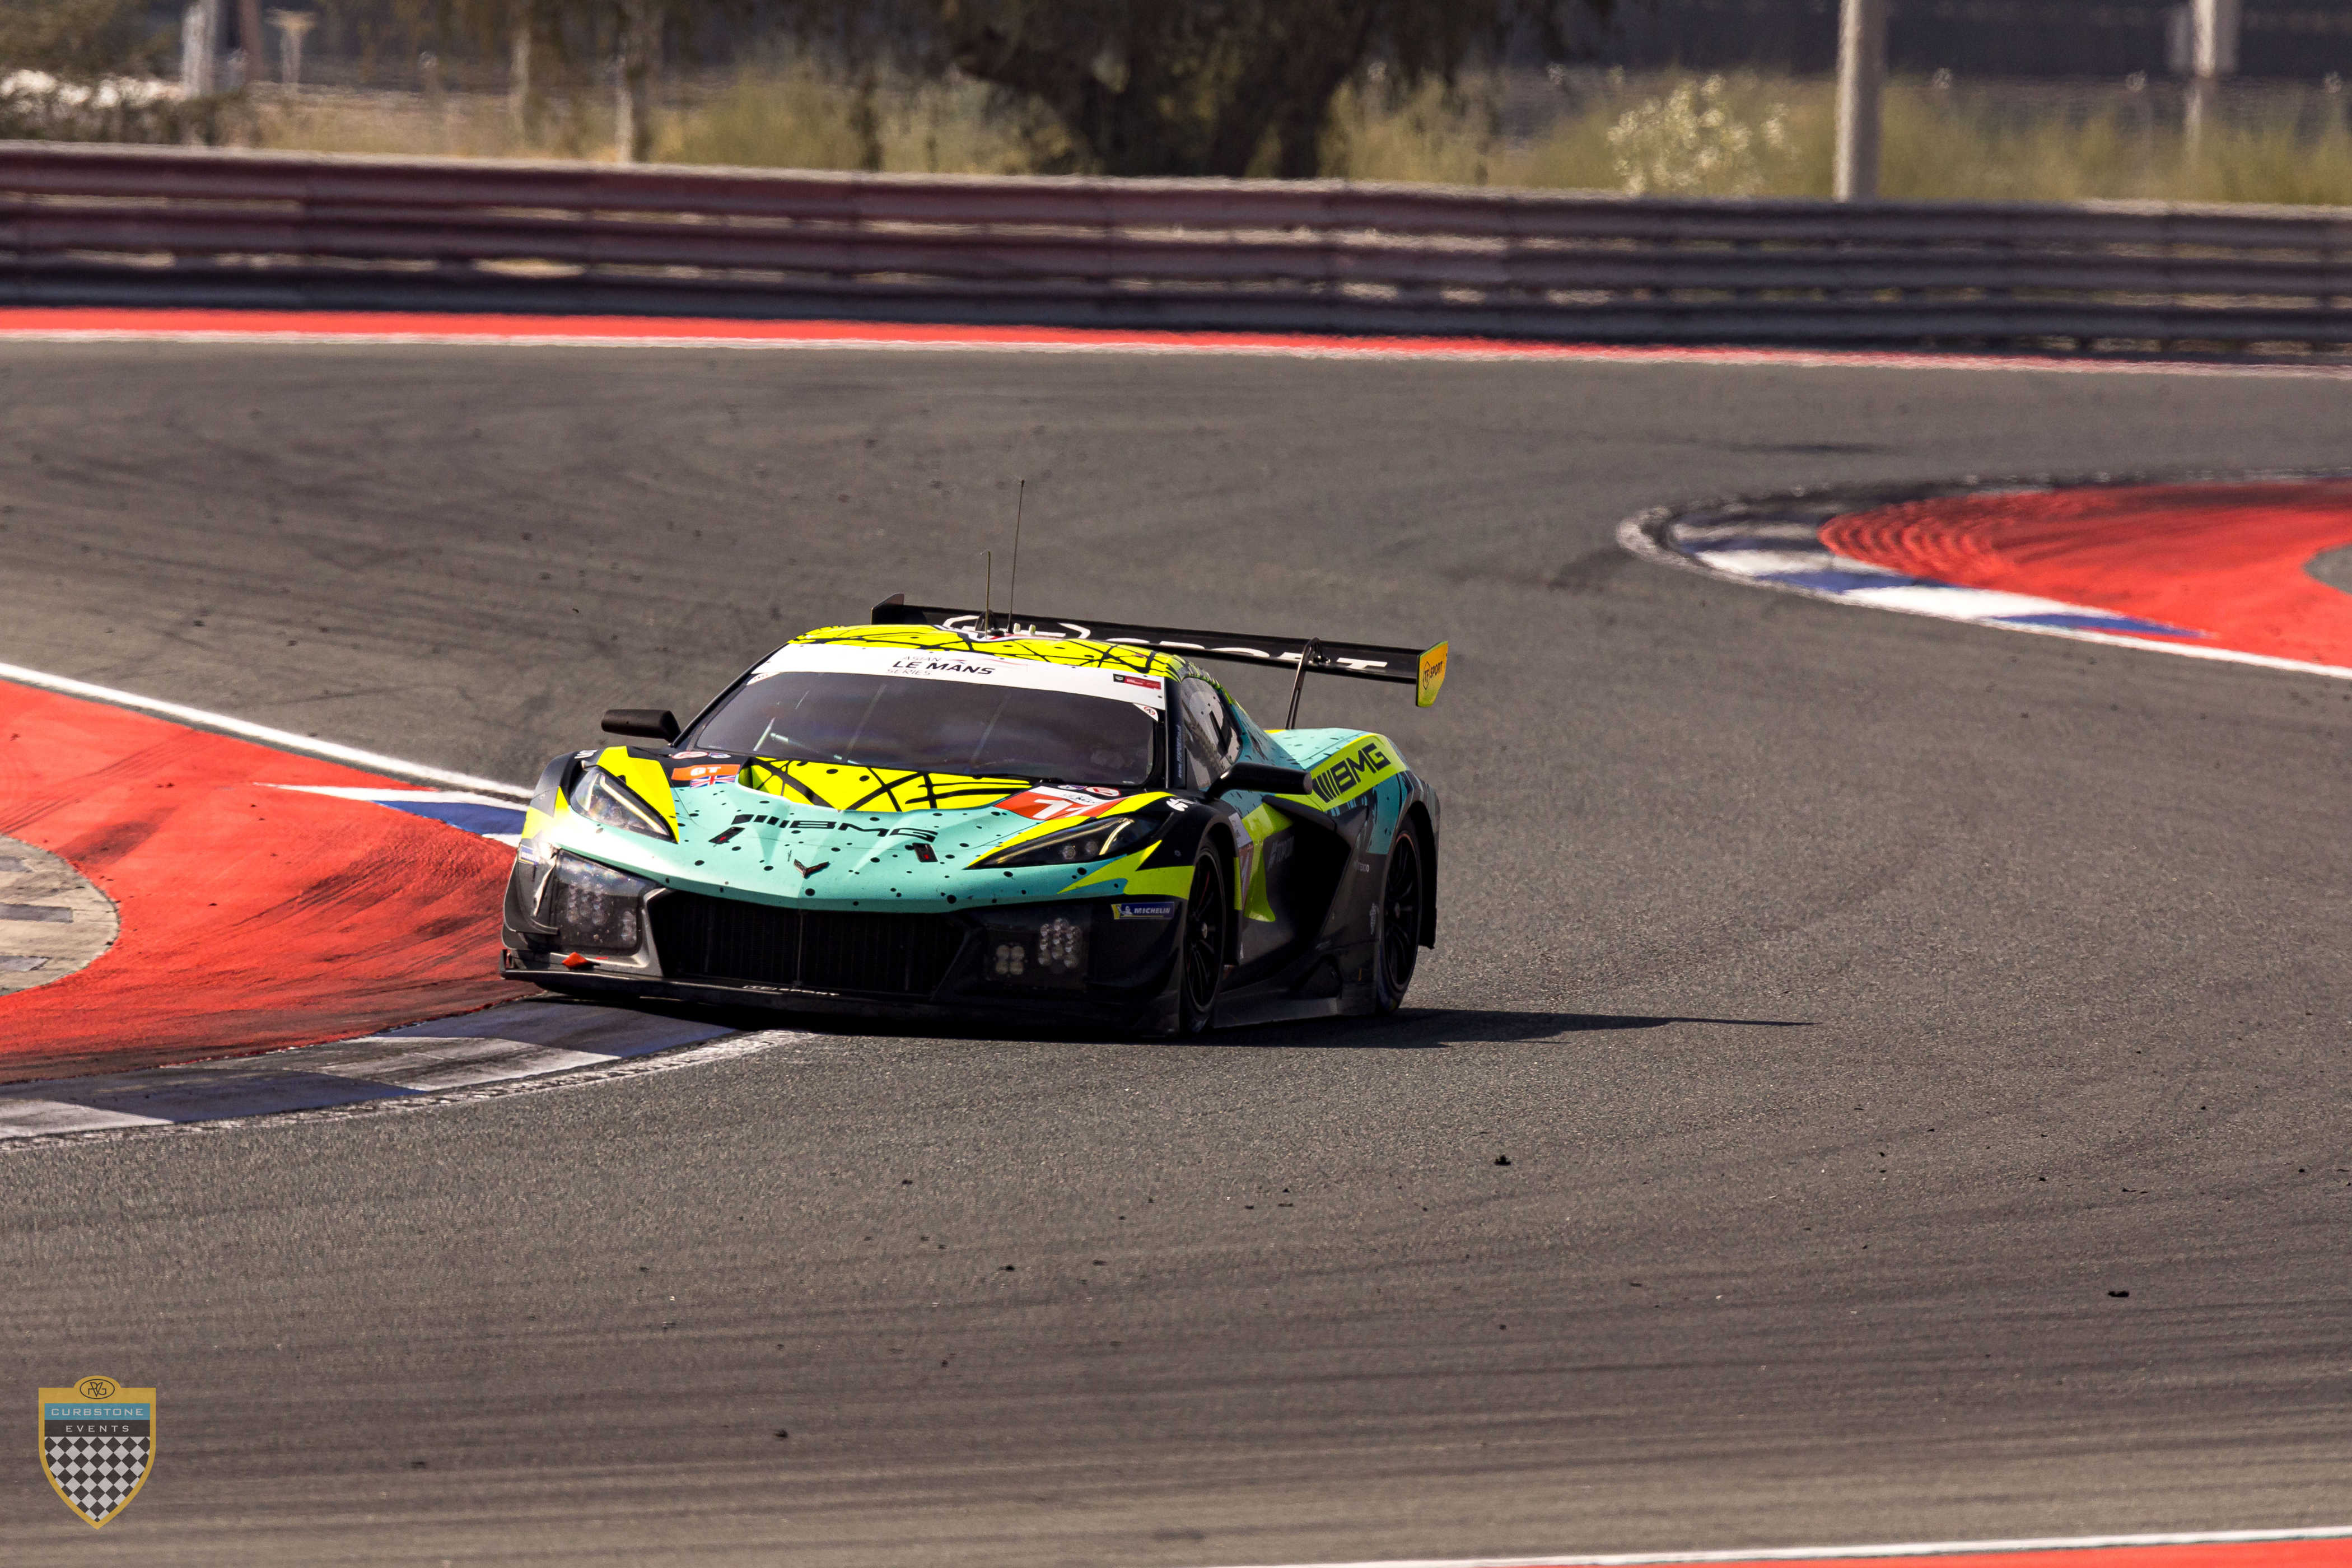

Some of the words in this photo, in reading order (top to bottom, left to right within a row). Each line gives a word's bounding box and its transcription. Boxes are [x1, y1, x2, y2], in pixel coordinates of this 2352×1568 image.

[926, 662, 996, 675] MANS
[1430, 661, 1443, 679] SPORT
[690, 766, 721, 776] GT
